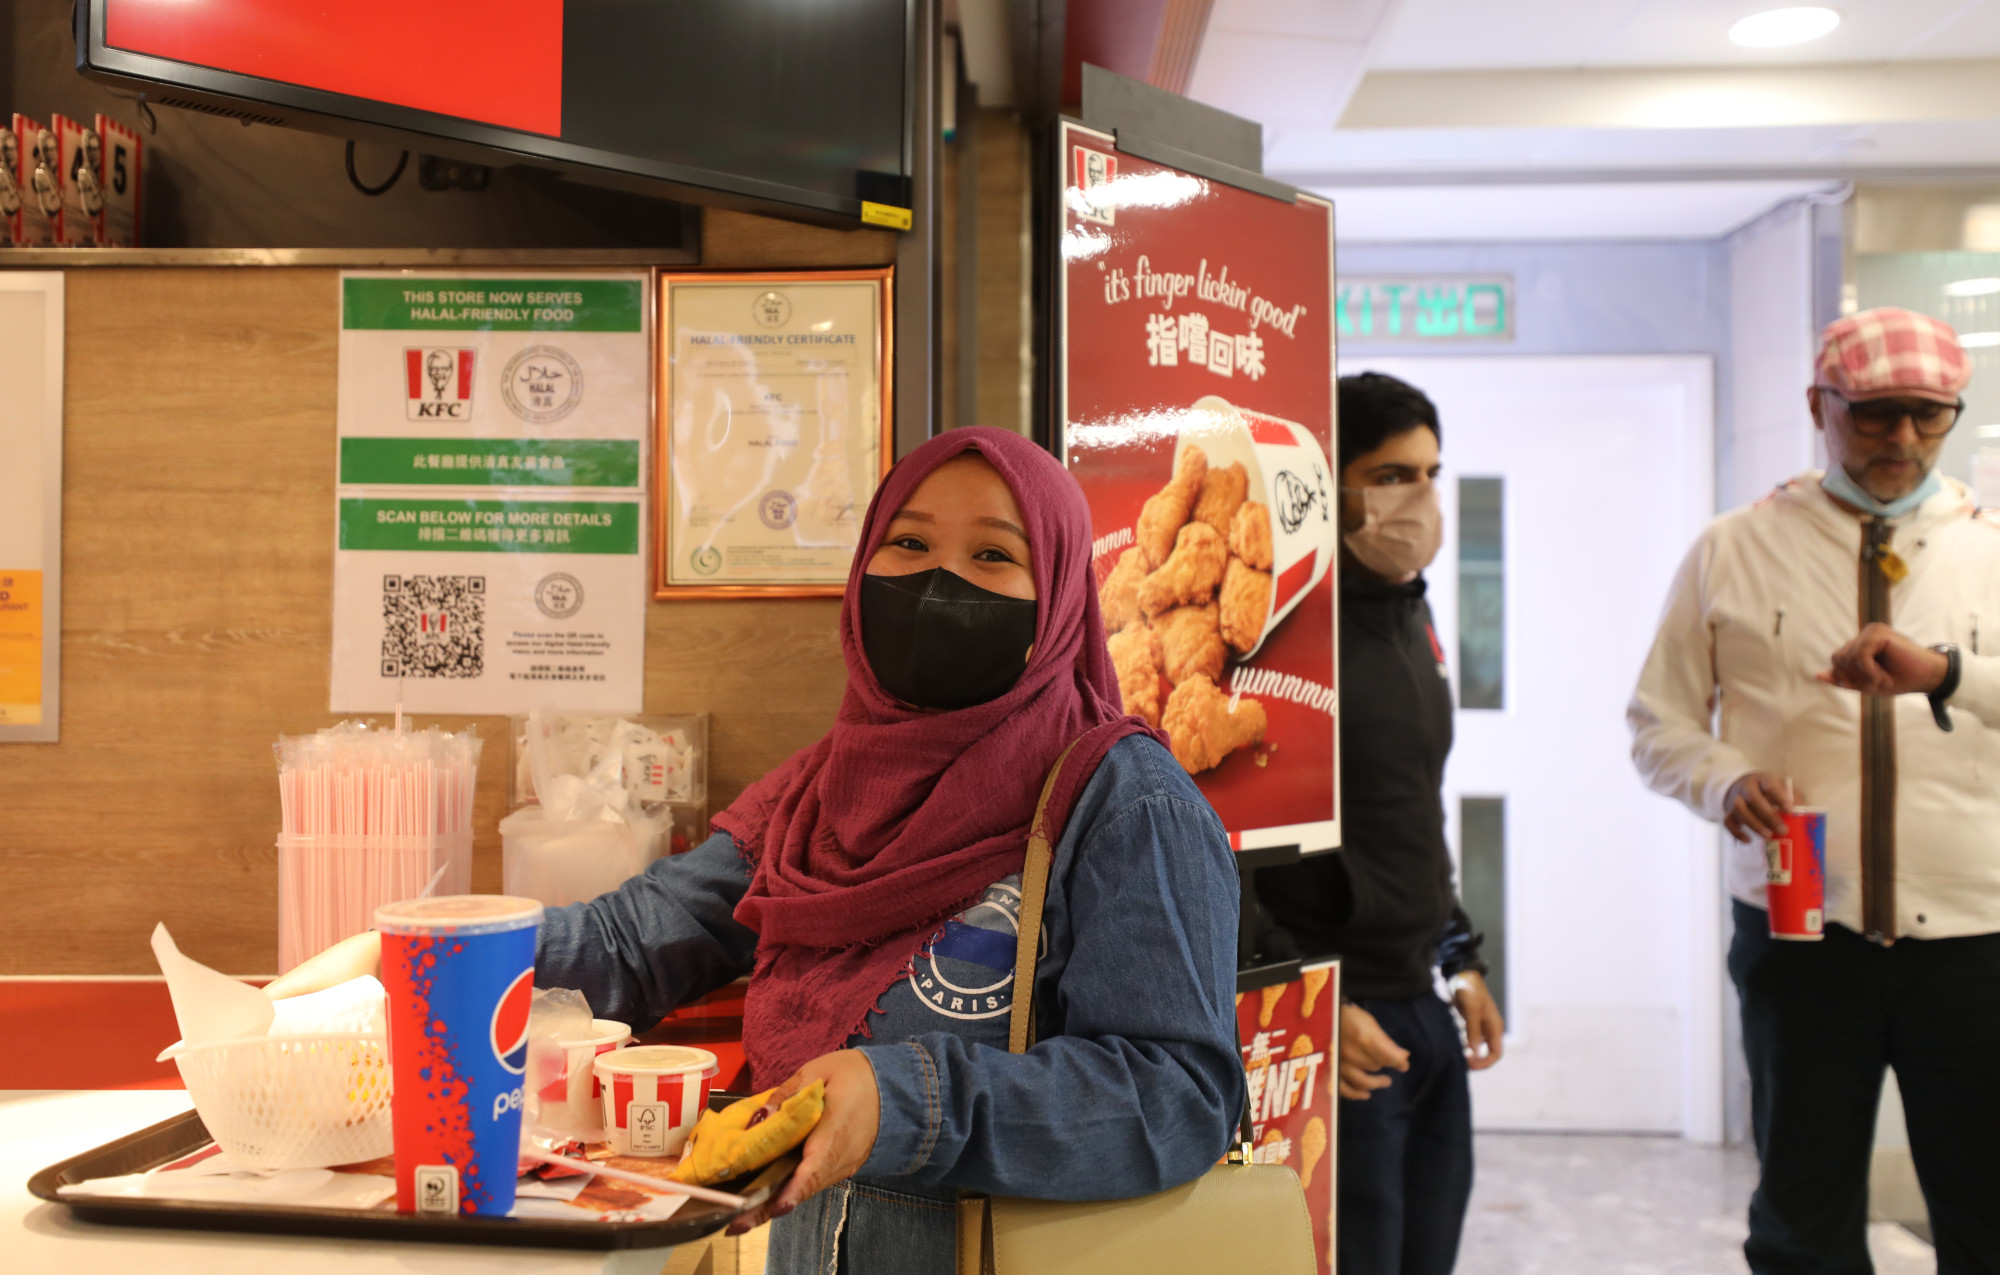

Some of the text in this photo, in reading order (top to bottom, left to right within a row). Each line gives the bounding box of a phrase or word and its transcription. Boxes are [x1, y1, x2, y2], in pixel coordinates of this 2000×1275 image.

[113, 144, 127, 195] 5
[1133, 255, 1195, 310] finger
[1196, 258, 1252, 312] lickin'
[403, 291, 583, 305] THIS STORE NOW SERVES
[411, 307, 575, 321] HALAL-FRIENDLY FOOD
[690, 334, 856, 346] HALAL-FRIENDLY CERTIFICATE
[1145, 312, 1266, 381] 指嚐回味
[418, 402, 461, 417] KFC
[376, 510, 613, 527] SCAN BELOW FOR MORE DETAILS
[921, 977, 999, 1012] PARIS
[493, 1083, 525, 1122] pe
